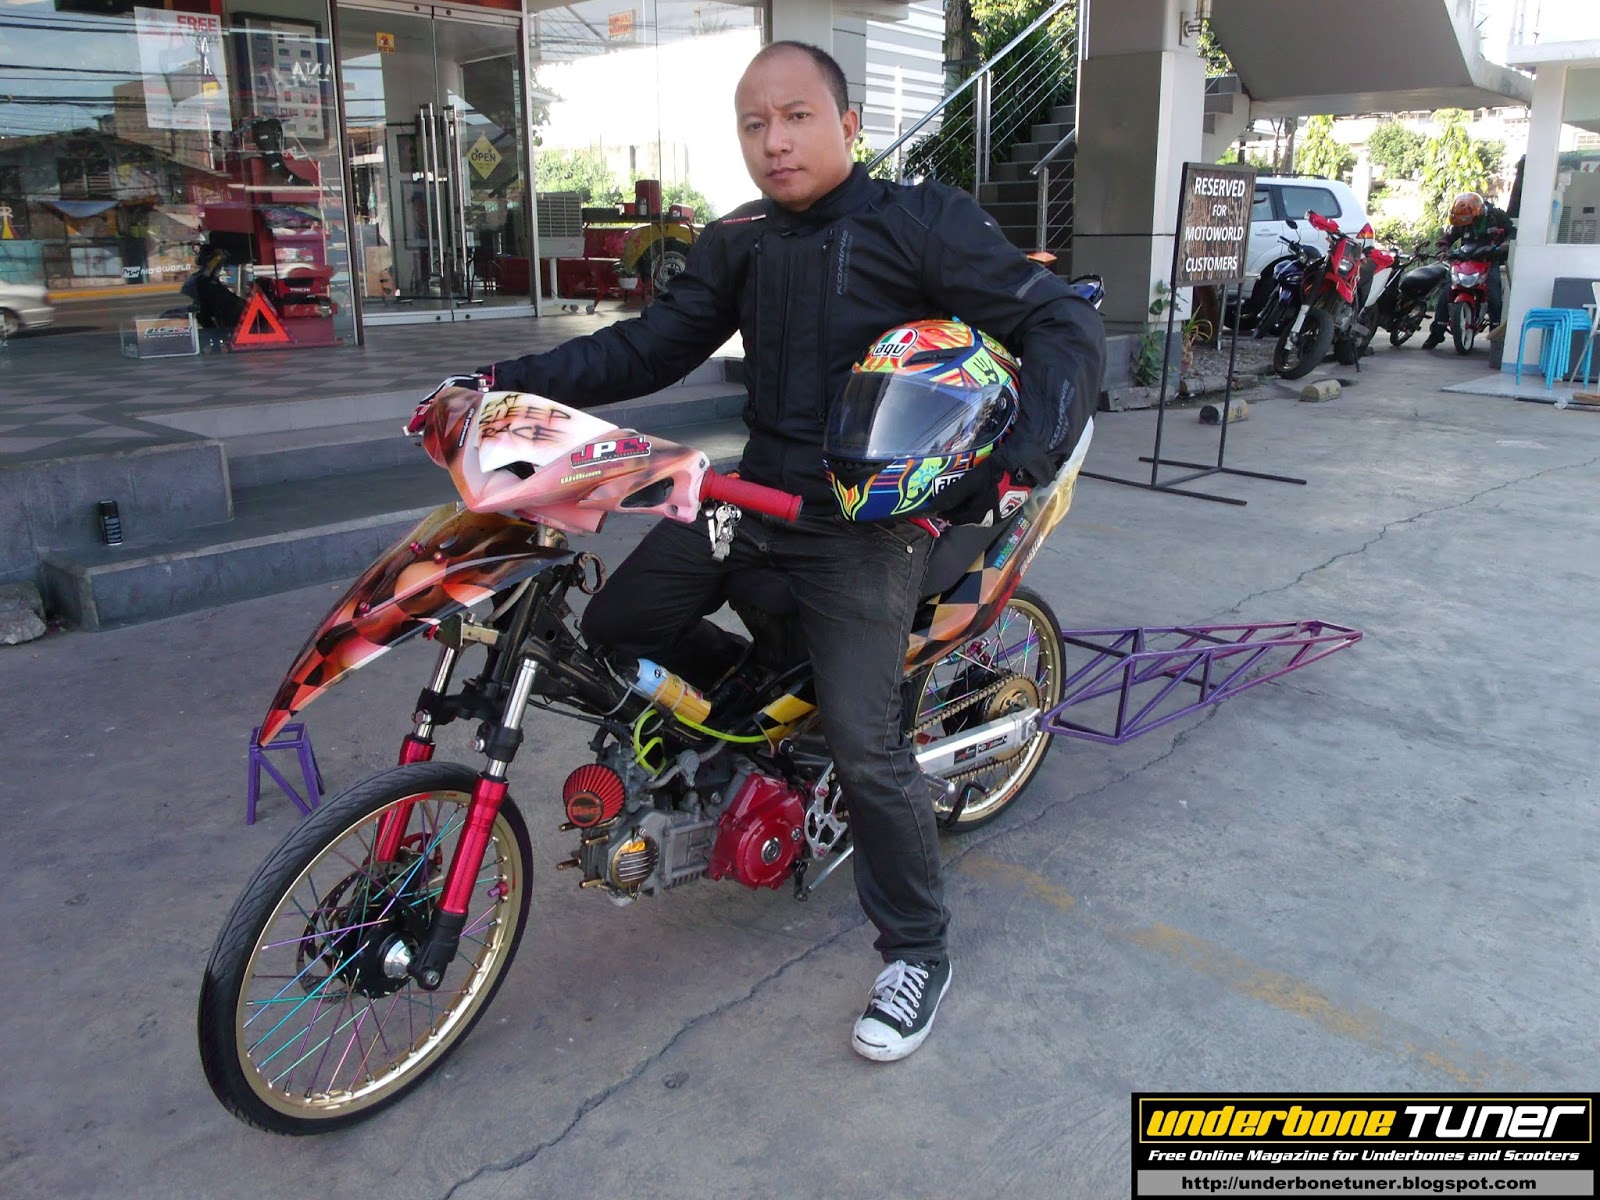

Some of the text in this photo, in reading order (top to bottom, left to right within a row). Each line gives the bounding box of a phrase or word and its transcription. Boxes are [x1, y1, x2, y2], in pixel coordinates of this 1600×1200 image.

[176, 15, 217, 32] FREE
[471, 152, 496, 162] OPEN
[1194, 177, 1246, 197] RESERVED
[1212, 205, 1227, 216] FOR
[1185, 226, 1244, 241] MOTOWORLD
[836, 230, 849, 295] KOMINE
[1185, 256, 1238, 272] CUSTOMERS
[481, 394, 520, 416] EAT
[481, 423, 567, 445] RACE
